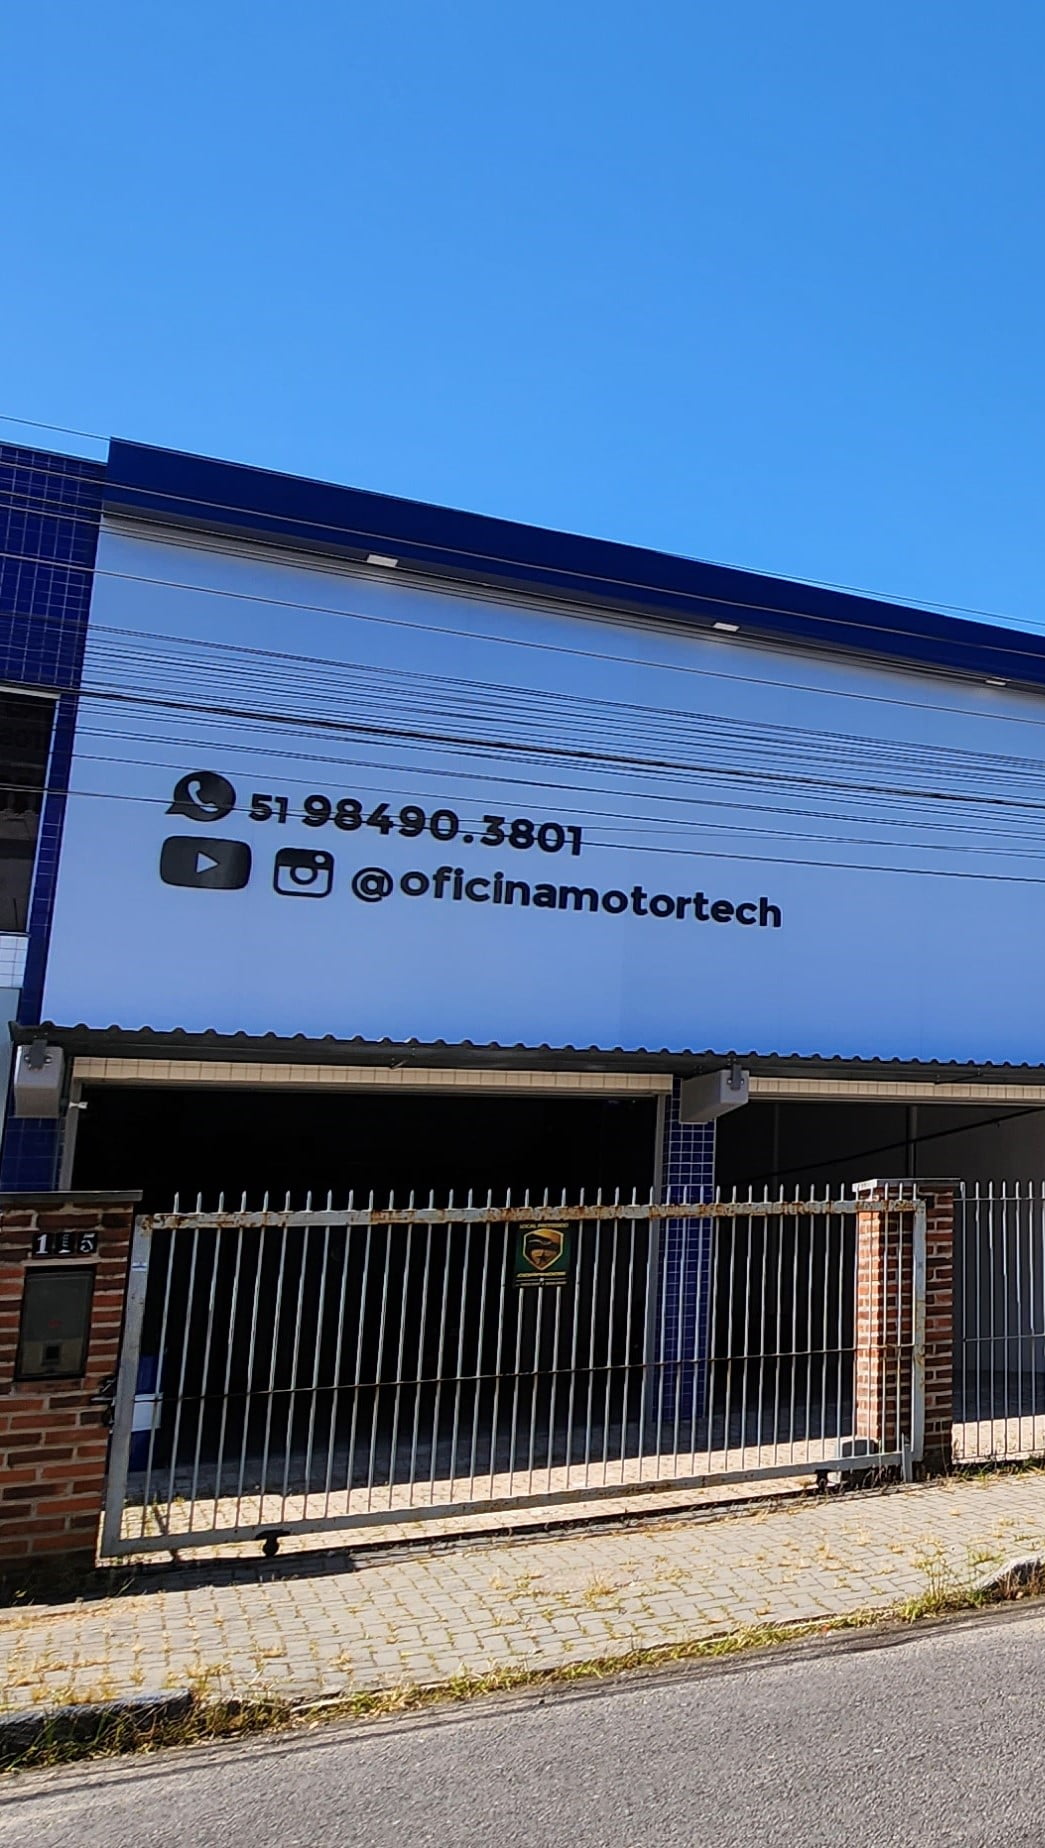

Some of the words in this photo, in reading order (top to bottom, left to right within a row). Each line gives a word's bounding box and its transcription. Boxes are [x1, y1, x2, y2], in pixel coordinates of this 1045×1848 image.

[249, 792, 289, 824] 51
[301, 793, 583, 856] 98490.3801
[350, 866, 783, 928] @oficinamotortech
